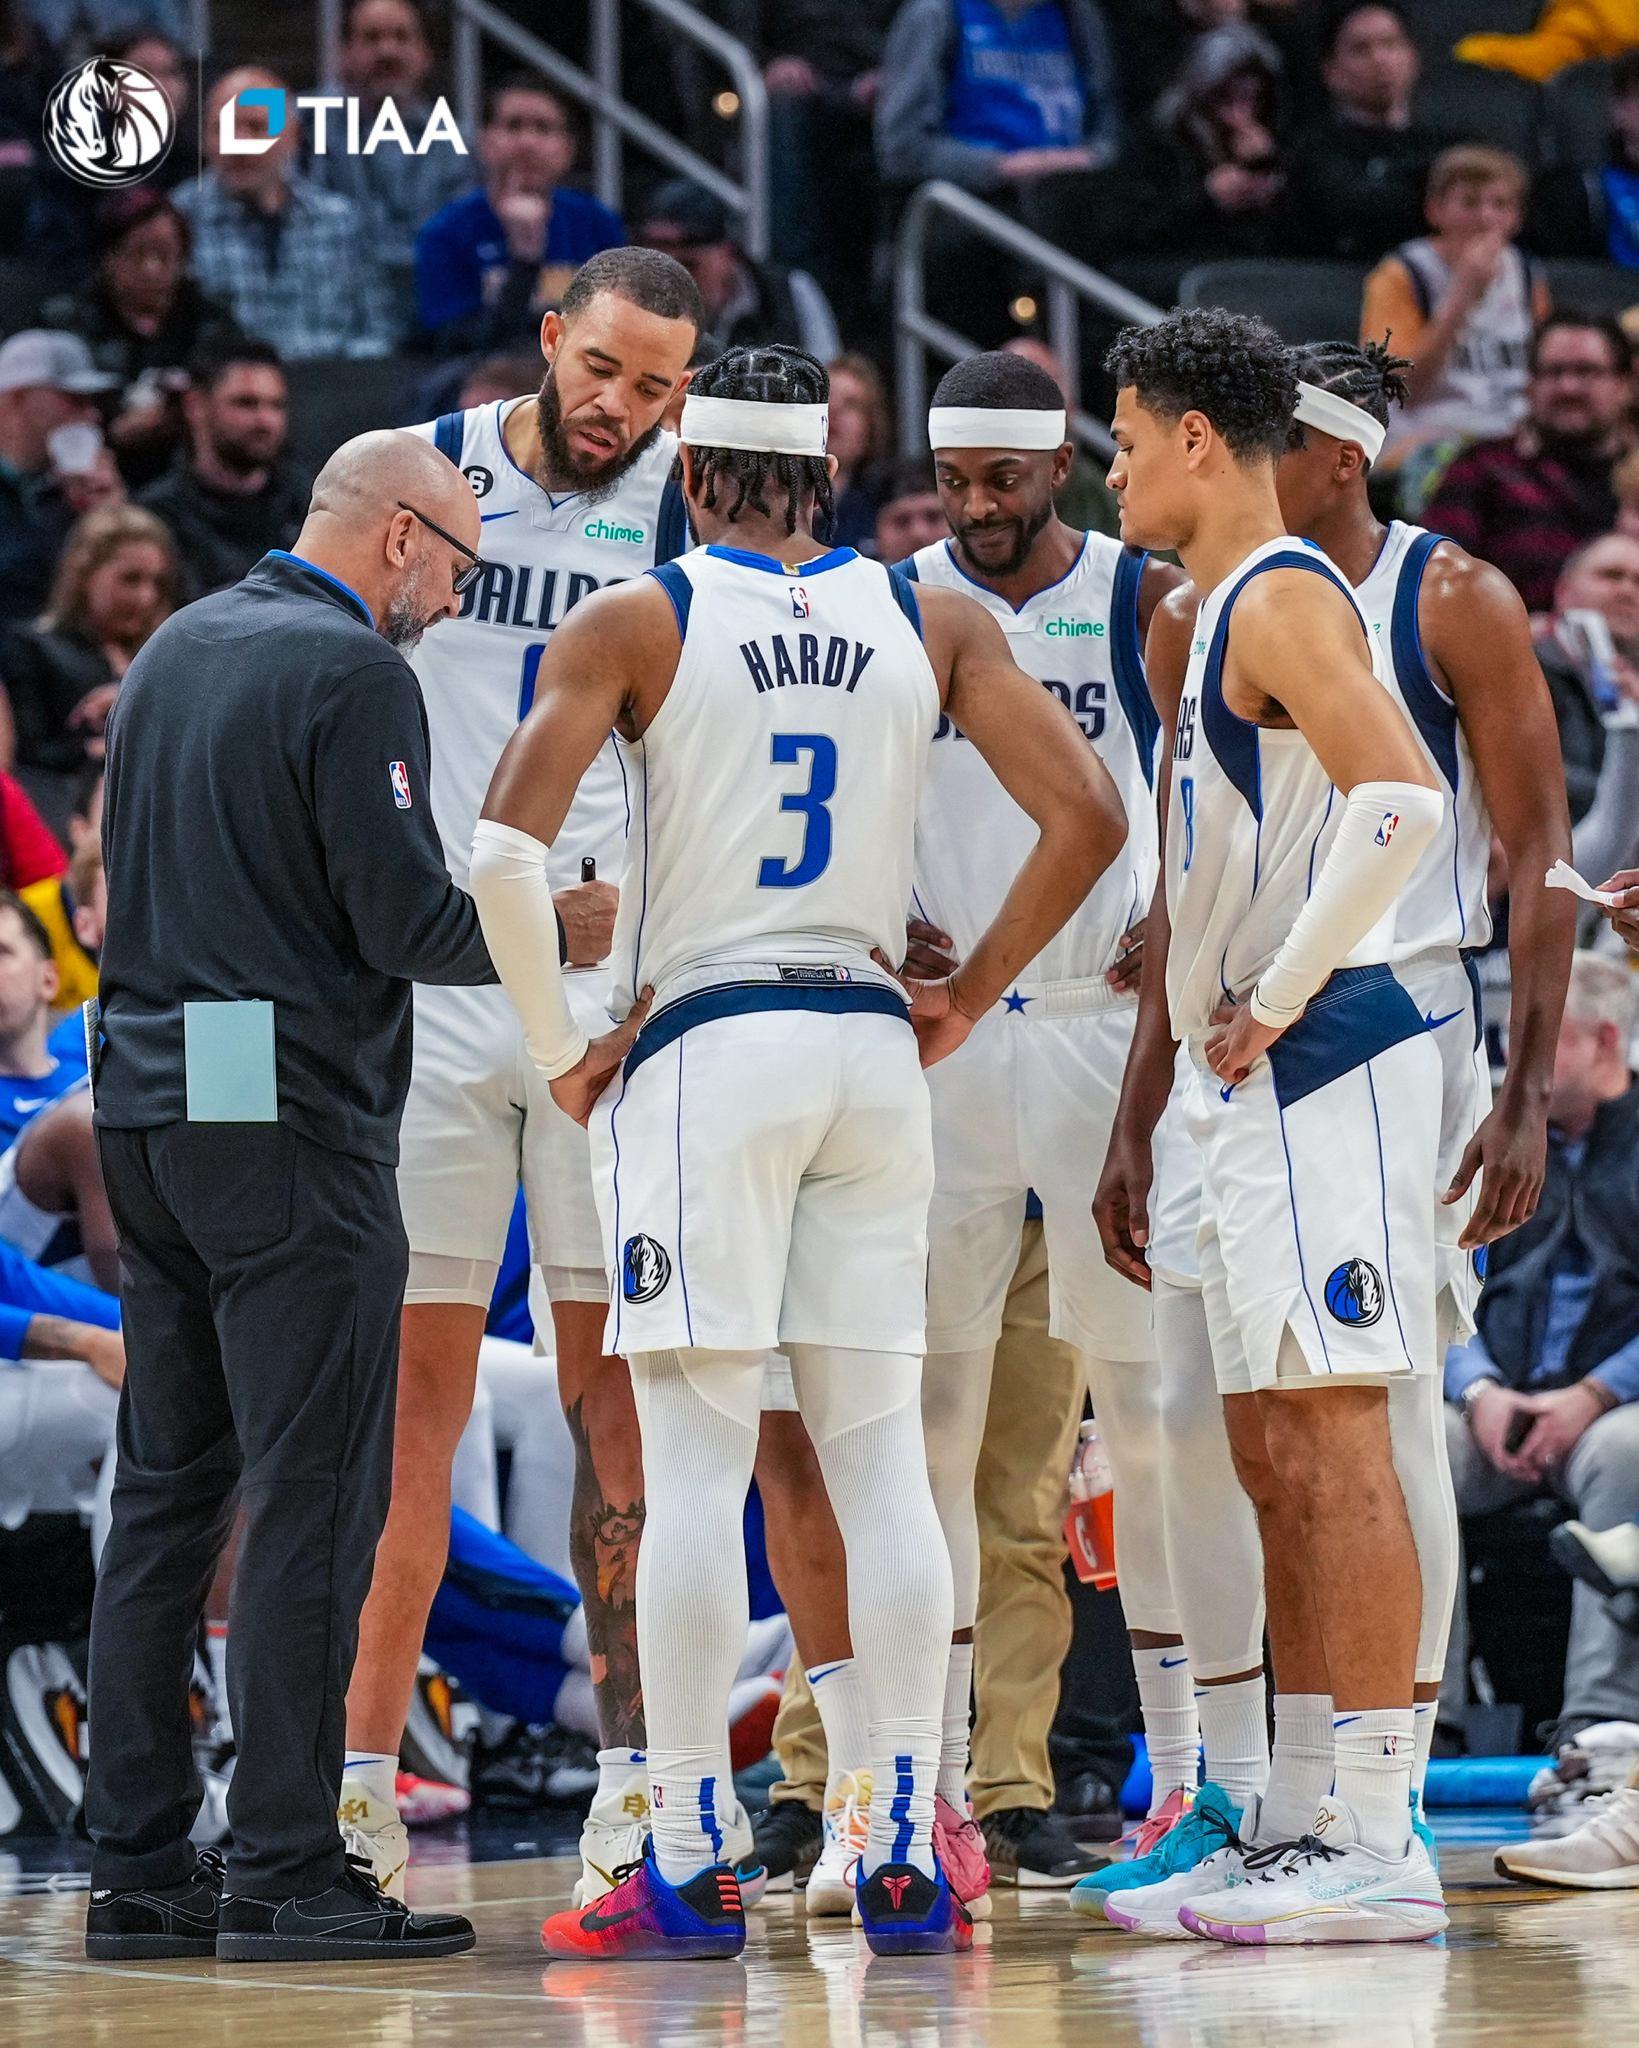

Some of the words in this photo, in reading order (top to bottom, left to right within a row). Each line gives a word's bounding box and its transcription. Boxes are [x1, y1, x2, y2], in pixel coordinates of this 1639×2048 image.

[584, 519, 645, 544] chime
[1045, 617, 1104, 637] chime
[739, 633, 875, 694] HARDY
[756, 732, 838, 889] 3
